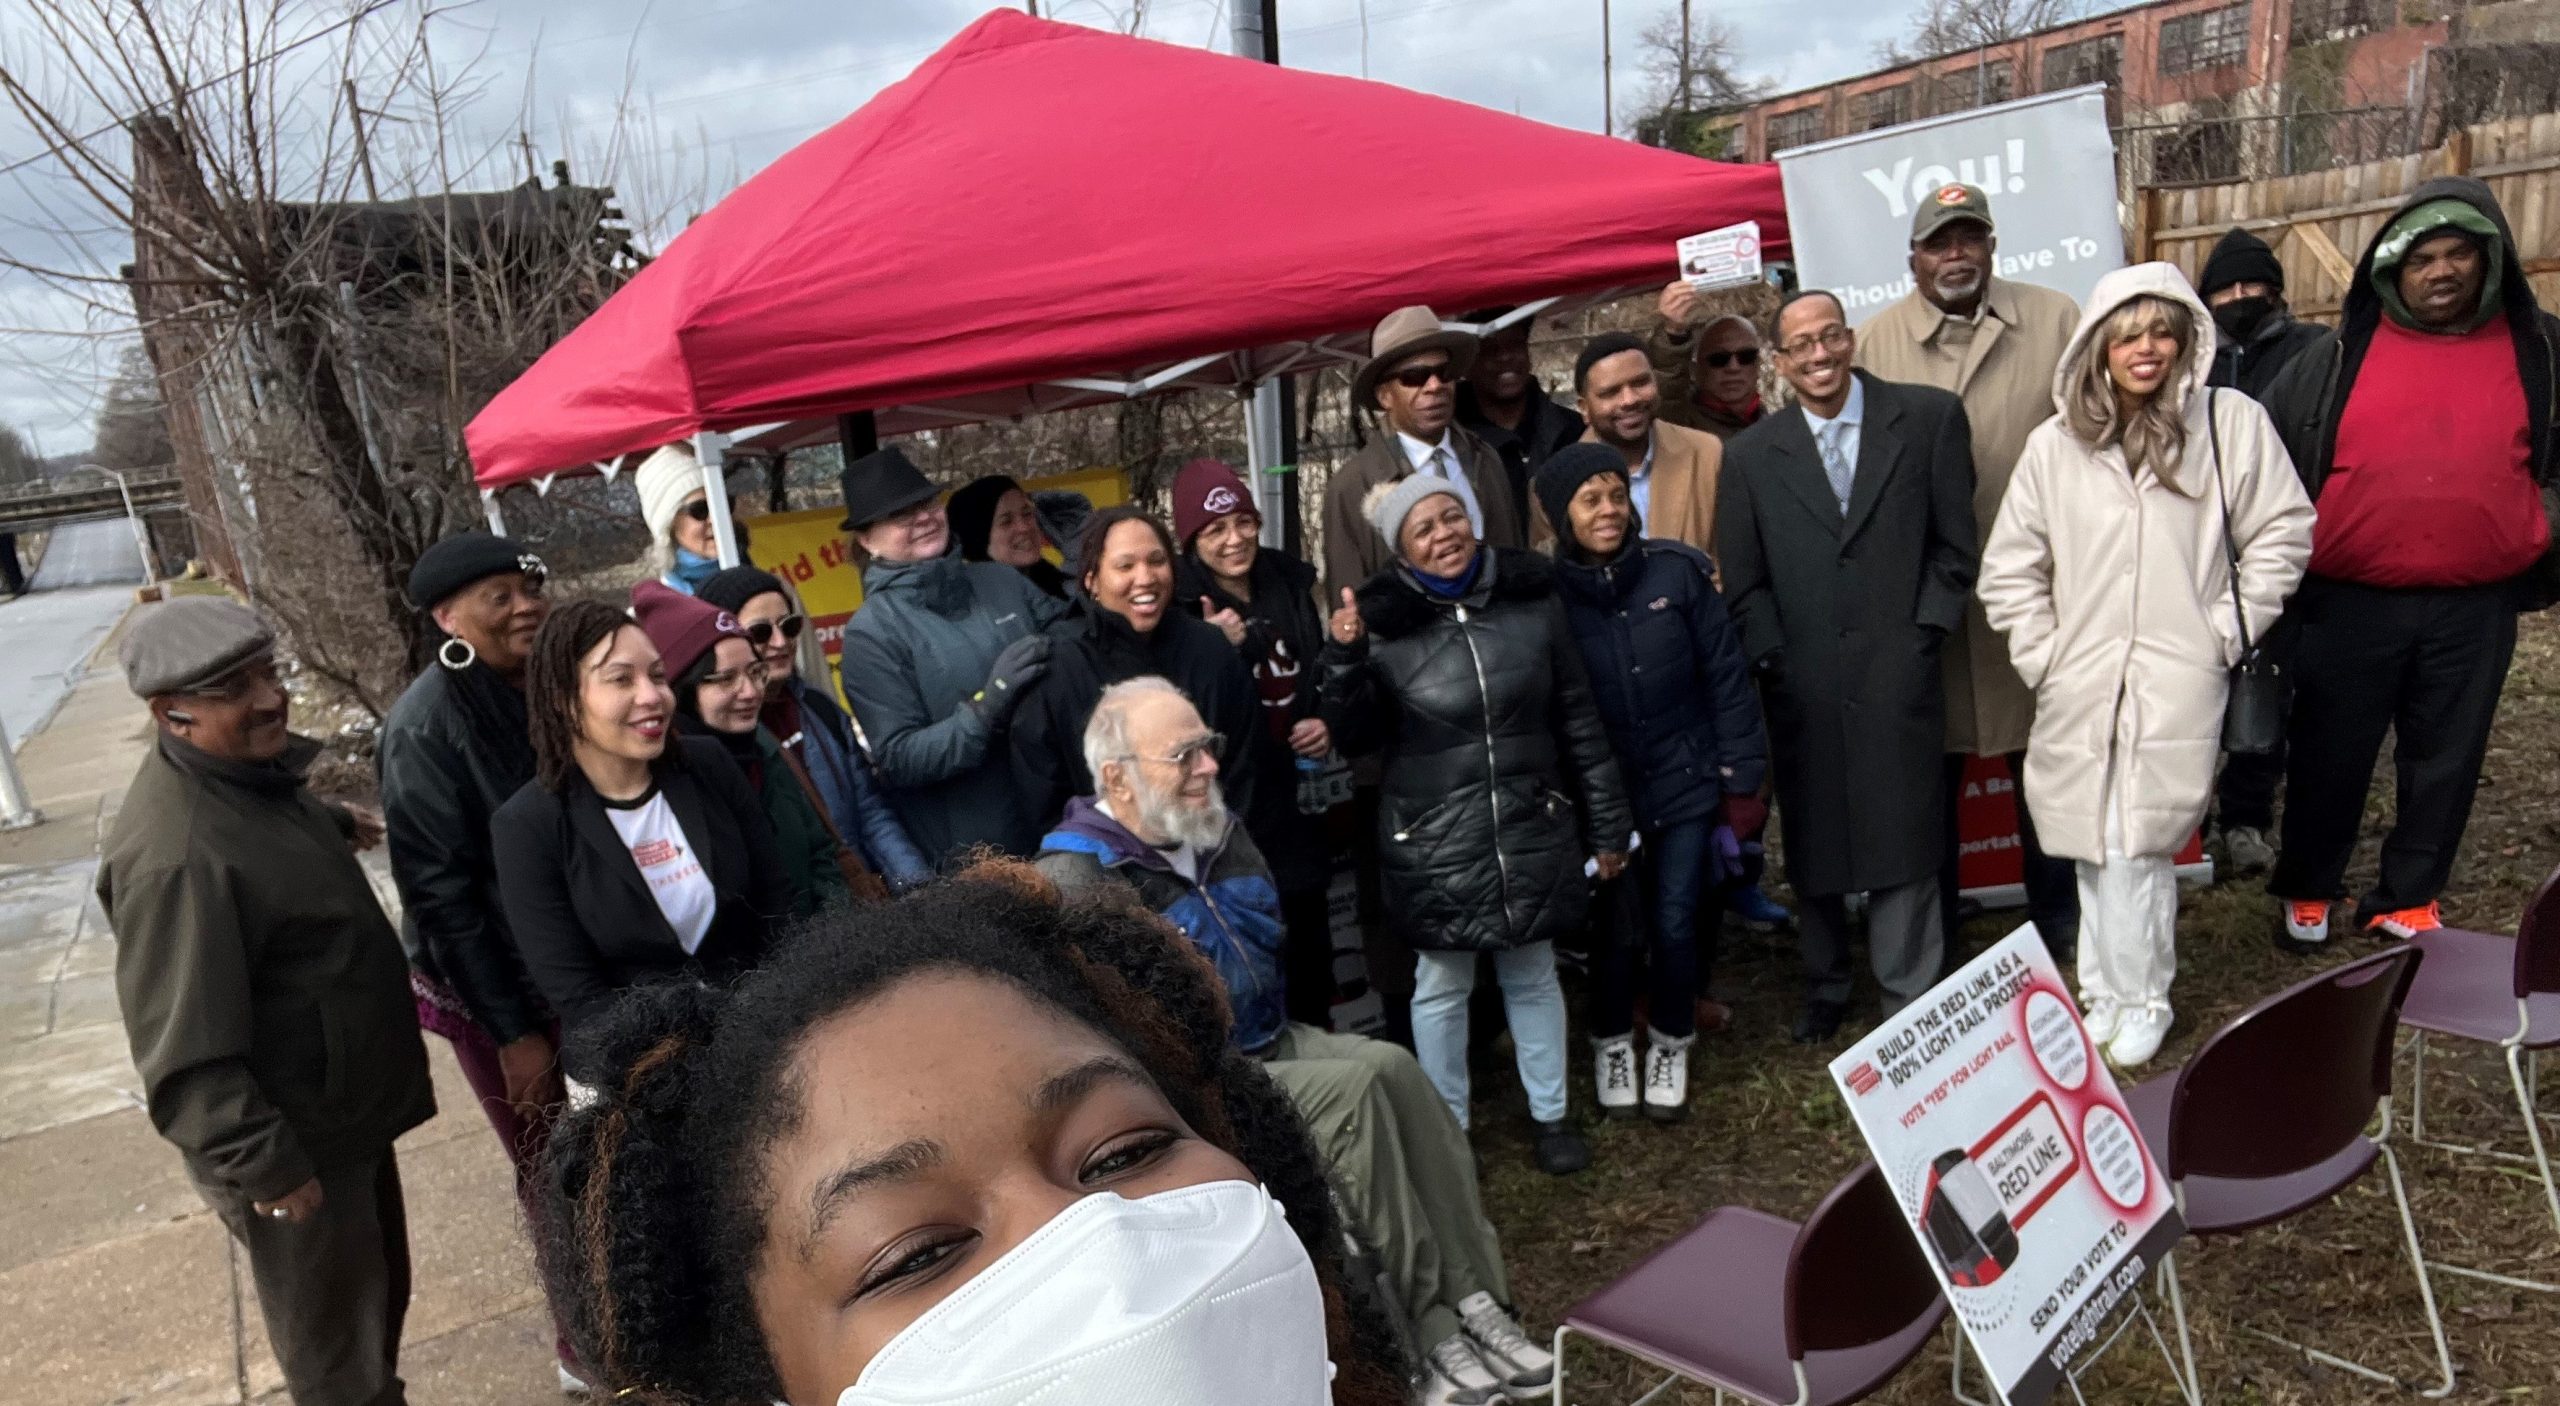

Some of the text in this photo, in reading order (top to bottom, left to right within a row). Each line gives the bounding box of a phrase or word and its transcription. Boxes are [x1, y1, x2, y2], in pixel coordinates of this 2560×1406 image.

[1862, 138, 2026, 218] You!
[1829, 273, 1917, 309] Shoul
[2060, 236, 2098, 261] To
[1965, 782, 1981, 799] A
[1876, 950, 2023, 1067] BUILD THE RED LINE AS A
[1886, 1053, 1922, 1089] 100%
[1919, 1026, 1957, 1063] LIGHT
[1956, 1007, 1985, 1037] RAIL
[1984, 966, 2036, 1015] PROJECT
[1899, 1101, 1927, 1129] VOTE
[1950, 1066, 1971, 1088] FOR
[1968, 1048, 1995, 1074] LIGHT
[1993, 1031, 2016, 1055] RAIL
[1987, 1127, 2035, 1177] BALTIMORE
[1998, 1163, 2030, 1205] RED
[2025, 1134, 2062, 1177] LINE
[2030, 1219, 2128, 1335] SEND YOUR VOTE TO
[2049, 1254, 2147, 1371] votelightrail.com
